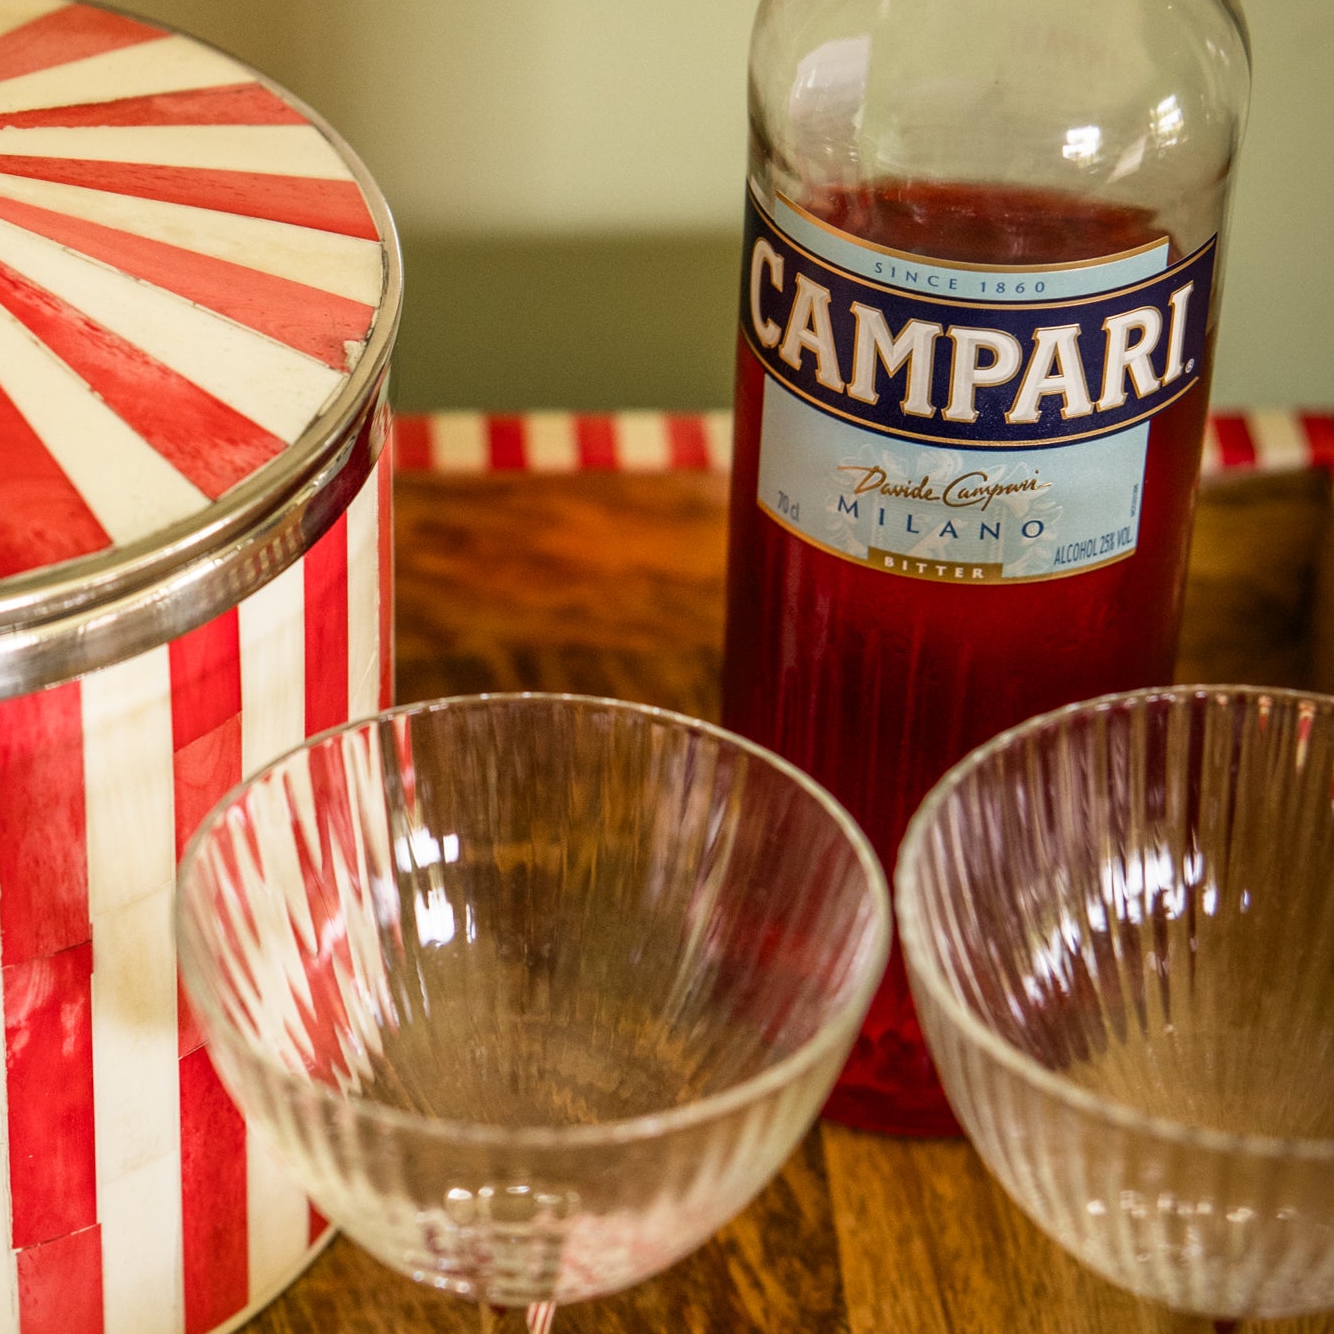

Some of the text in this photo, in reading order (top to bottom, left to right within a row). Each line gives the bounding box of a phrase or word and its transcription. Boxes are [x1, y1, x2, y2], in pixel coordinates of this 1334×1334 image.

[874, 262, 1046, 294] SINCE 1860
[749, 236, 1196, 425] CAMPARI
[837, 465, 1053, 512] Davide Campari
[837, 494, 1045, 541] MILANO
[884, 555, 985, 580] BITTER
[1053, 538, 1098, 566] ALCOHOL
